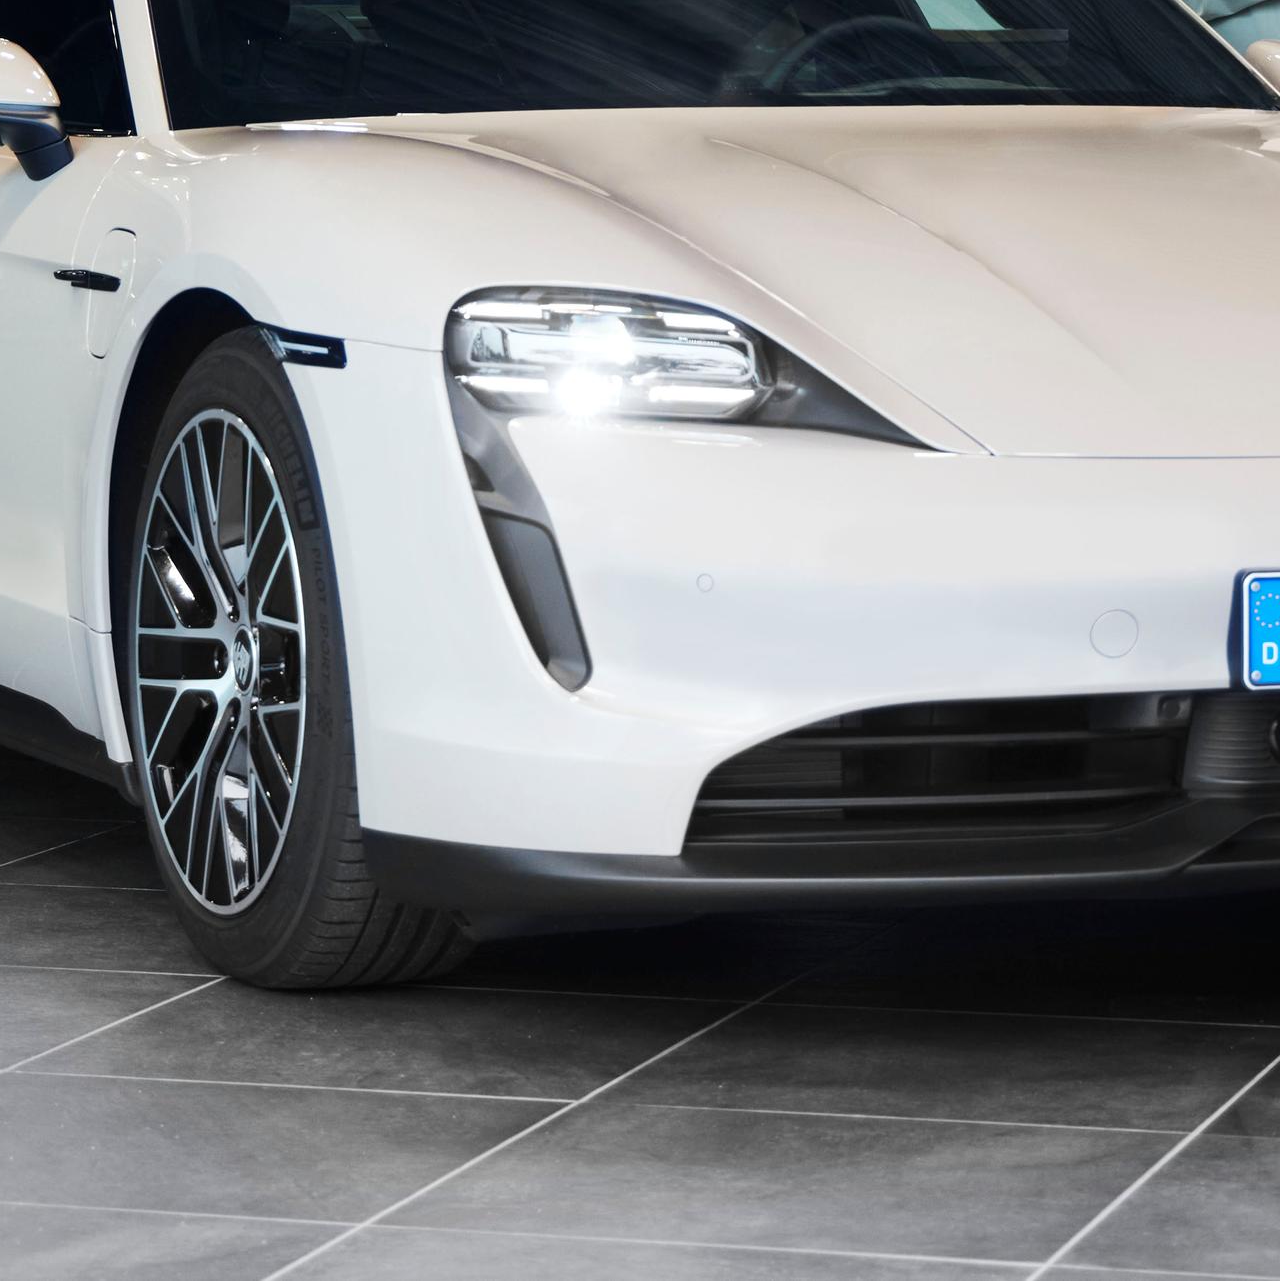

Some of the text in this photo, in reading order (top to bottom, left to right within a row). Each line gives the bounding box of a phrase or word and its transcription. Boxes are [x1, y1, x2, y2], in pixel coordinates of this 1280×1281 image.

[311, 547, 328, 606] PILOT
[318, 612, 331, 685] SPORT
[1262, 641, 1278, 665] D
